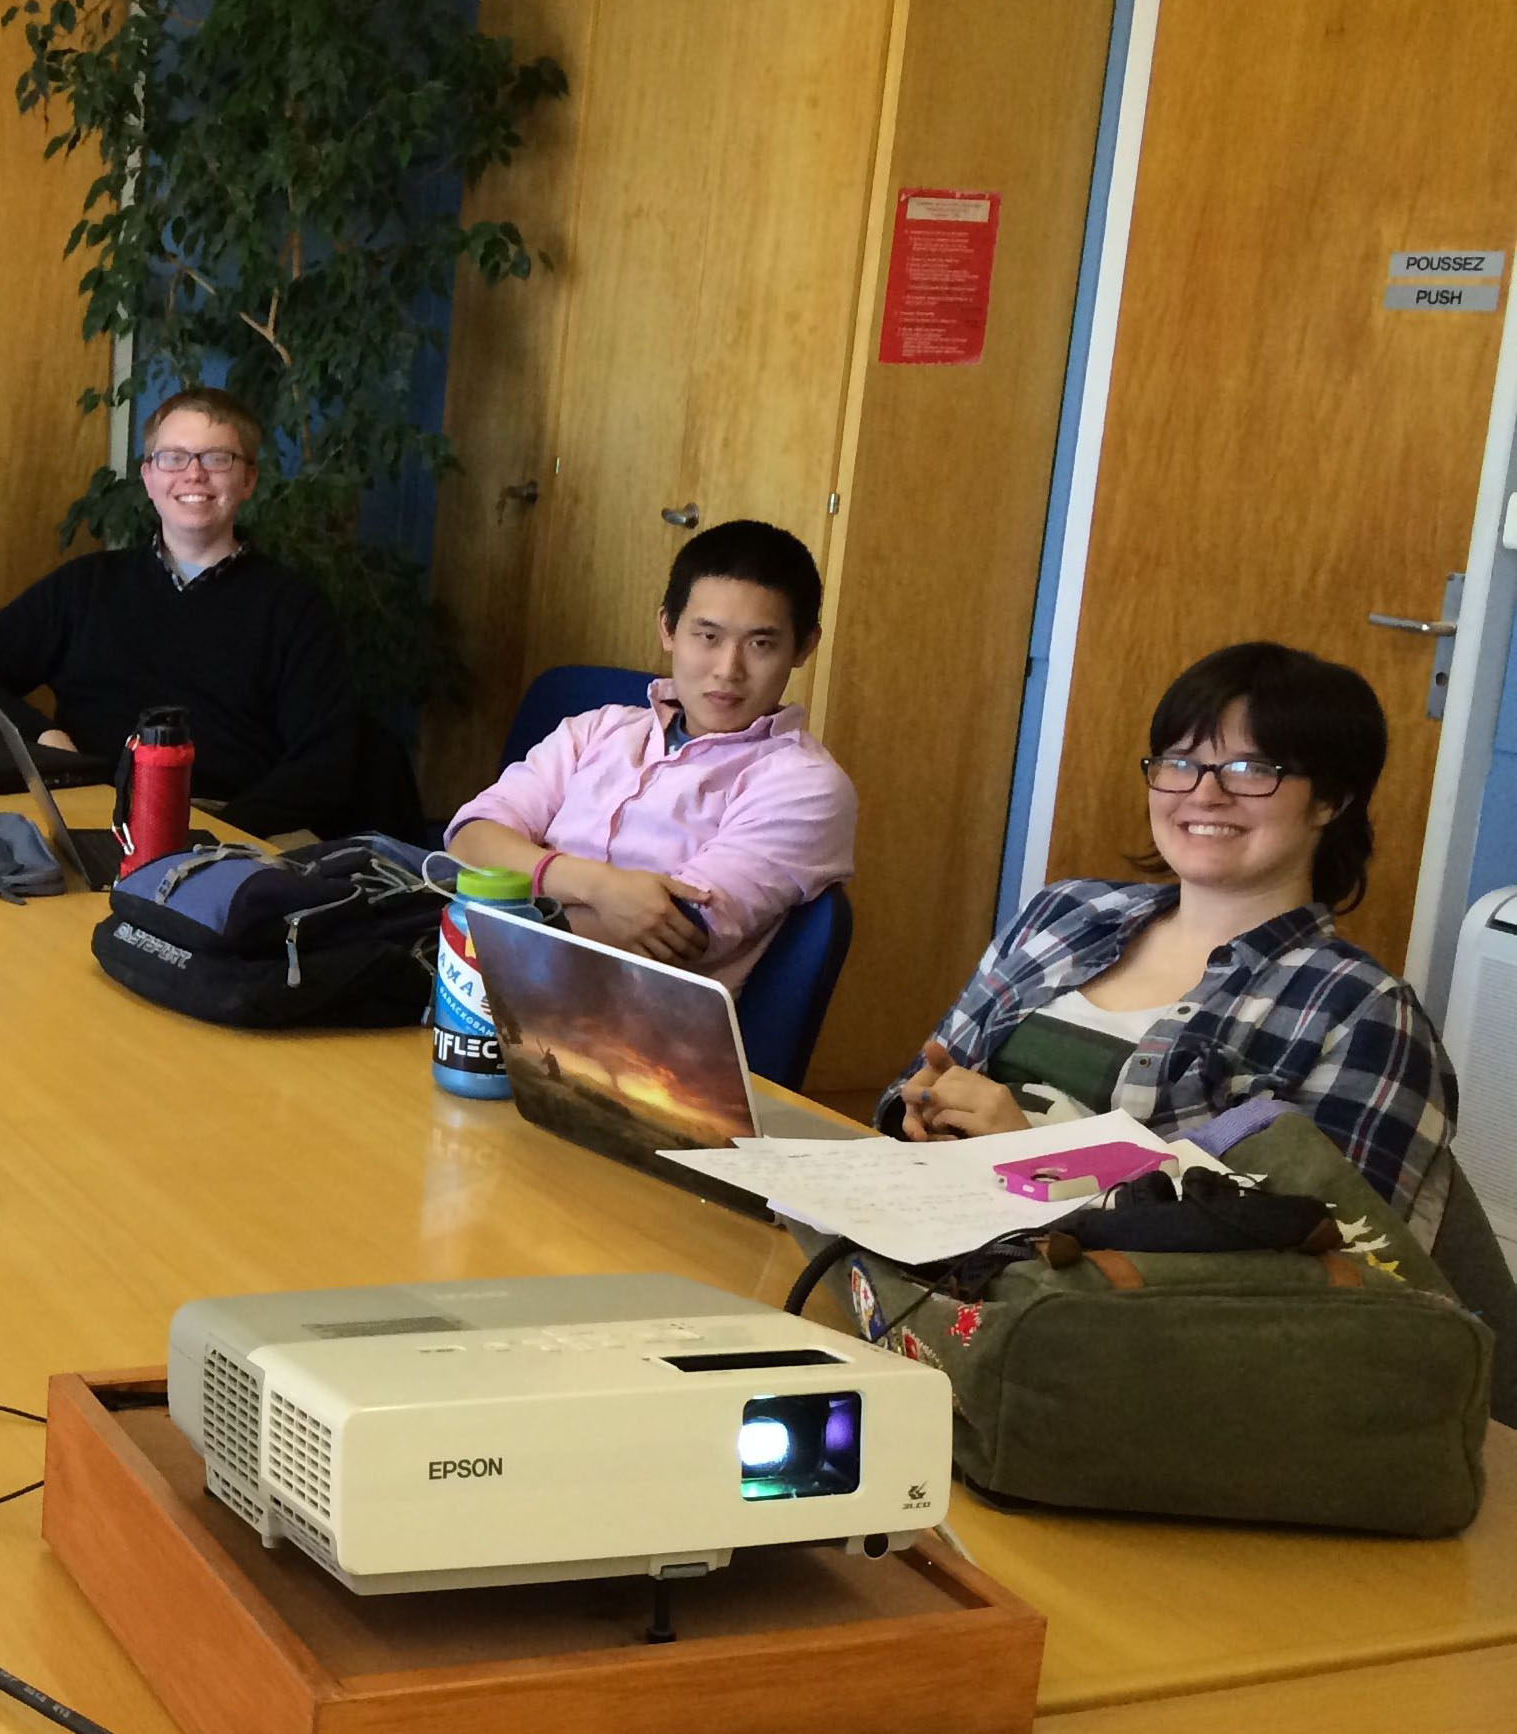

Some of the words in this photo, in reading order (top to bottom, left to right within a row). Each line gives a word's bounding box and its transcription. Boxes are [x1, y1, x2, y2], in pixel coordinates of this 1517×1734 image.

[1406, 256, 1485, 271] POUSSEZ
[1416, 289, 1462, 305] PUSH
[429, 1457, 502, 1480] EPSON
